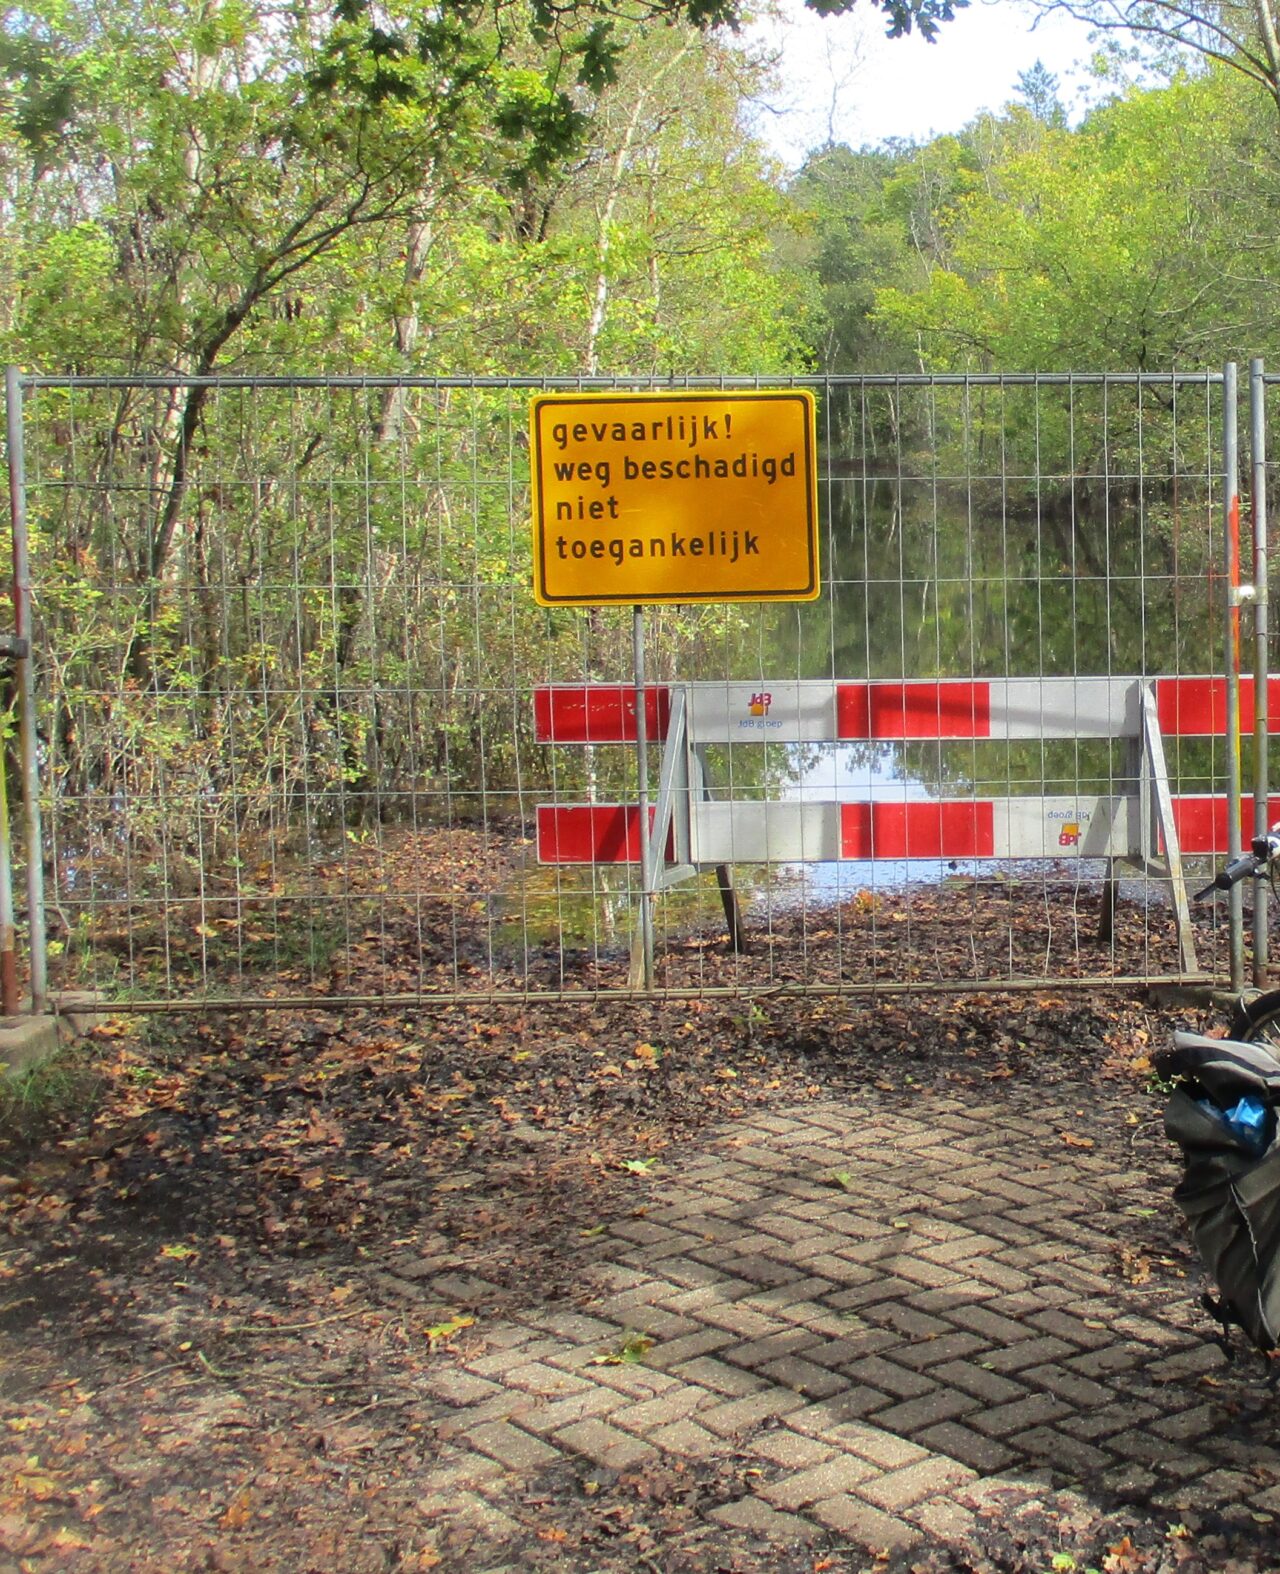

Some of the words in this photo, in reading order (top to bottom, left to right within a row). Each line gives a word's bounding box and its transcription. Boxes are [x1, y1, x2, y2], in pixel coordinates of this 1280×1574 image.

[552, 413, 732, 449] gevaarlijk!
[553, 461, 611, 488] weg
[623, 452, 797, 485] beschadigd
[556, 495, 620, 521] niet
[555, 531, 761, 566] toegankelijk
